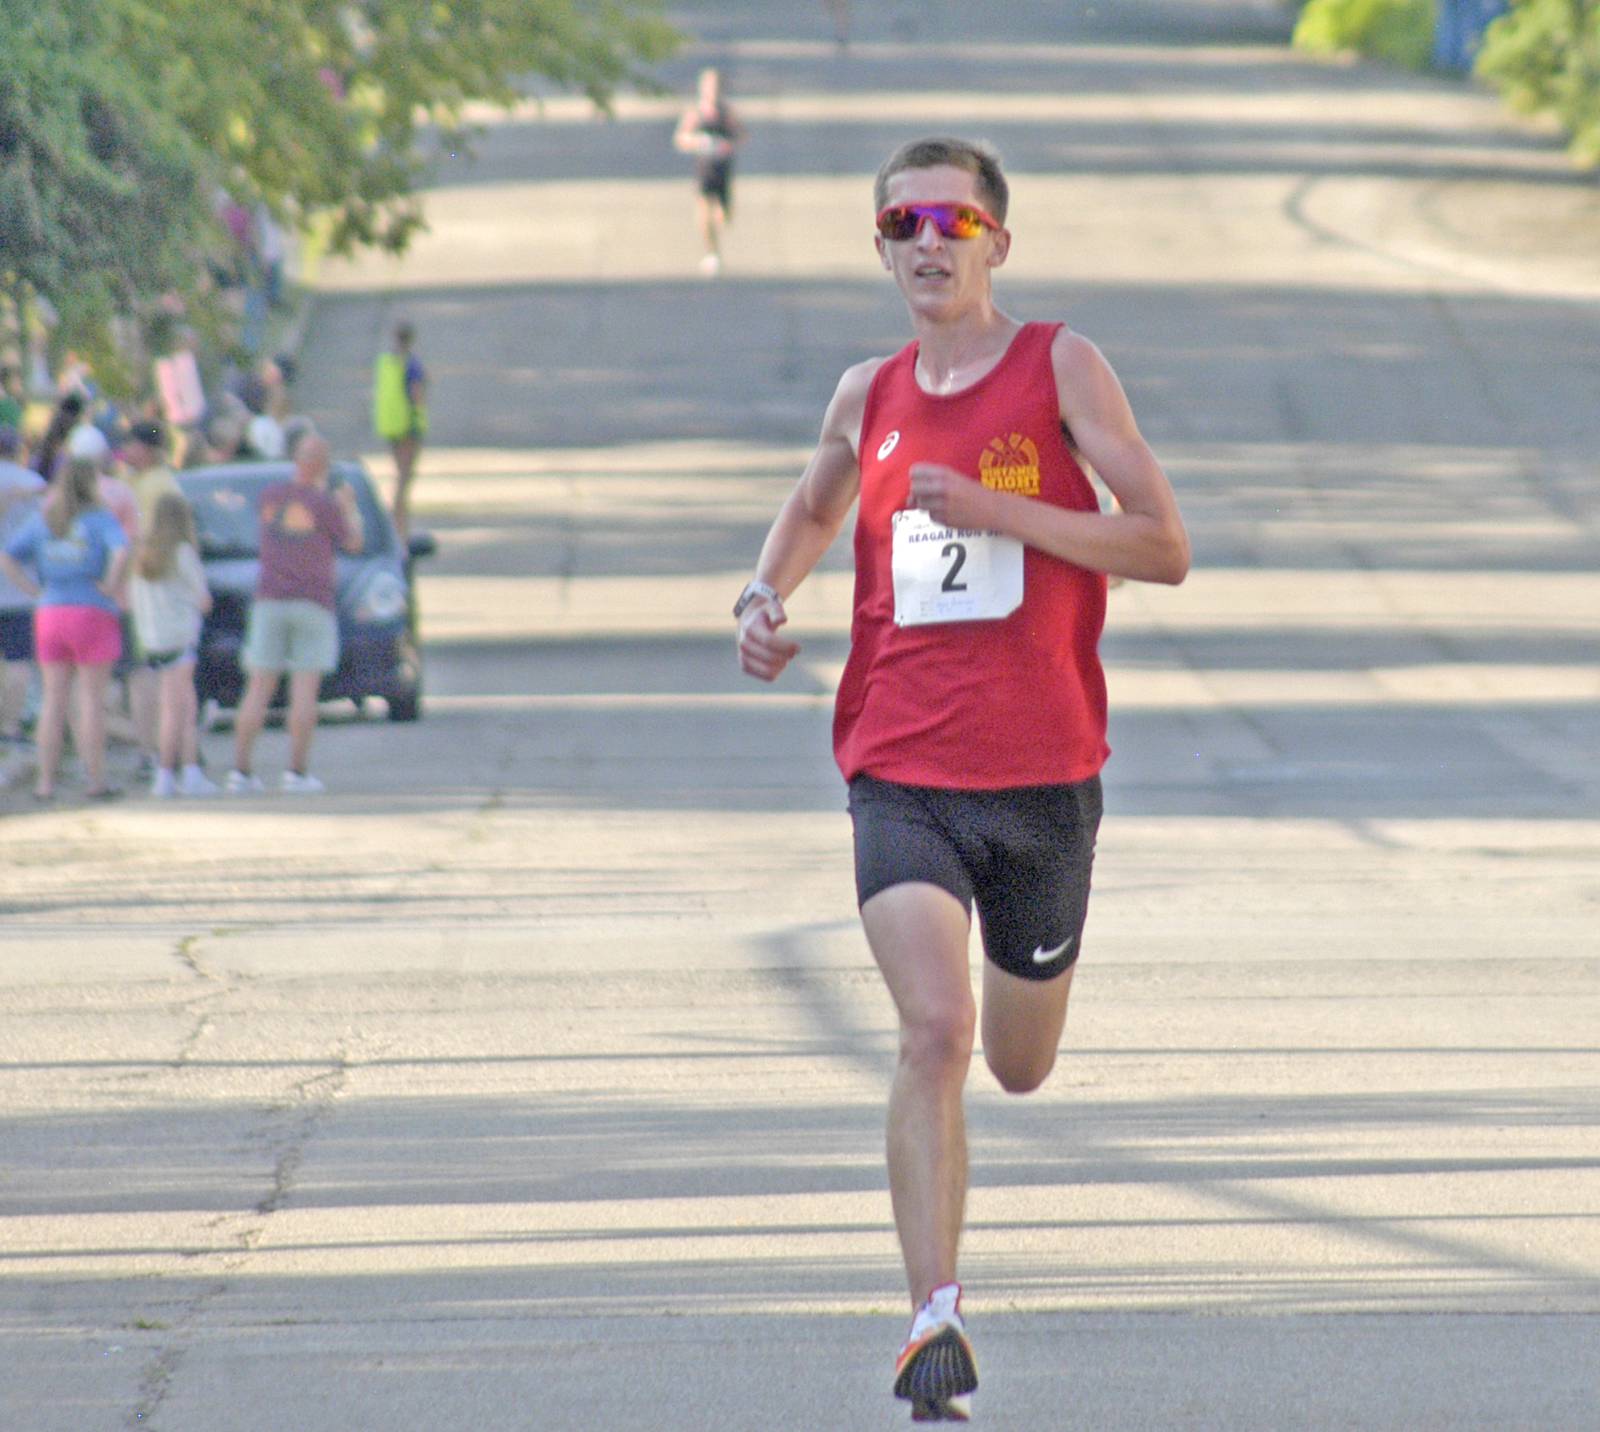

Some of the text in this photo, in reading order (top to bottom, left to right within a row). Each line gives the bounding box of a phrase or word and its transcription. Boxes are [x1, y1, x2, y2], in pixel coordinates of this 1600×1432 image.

[908, 527, 953, 543] REAGAN
[957, 527, 981, 538] RUN
[941, 542, 967, 593] 2
